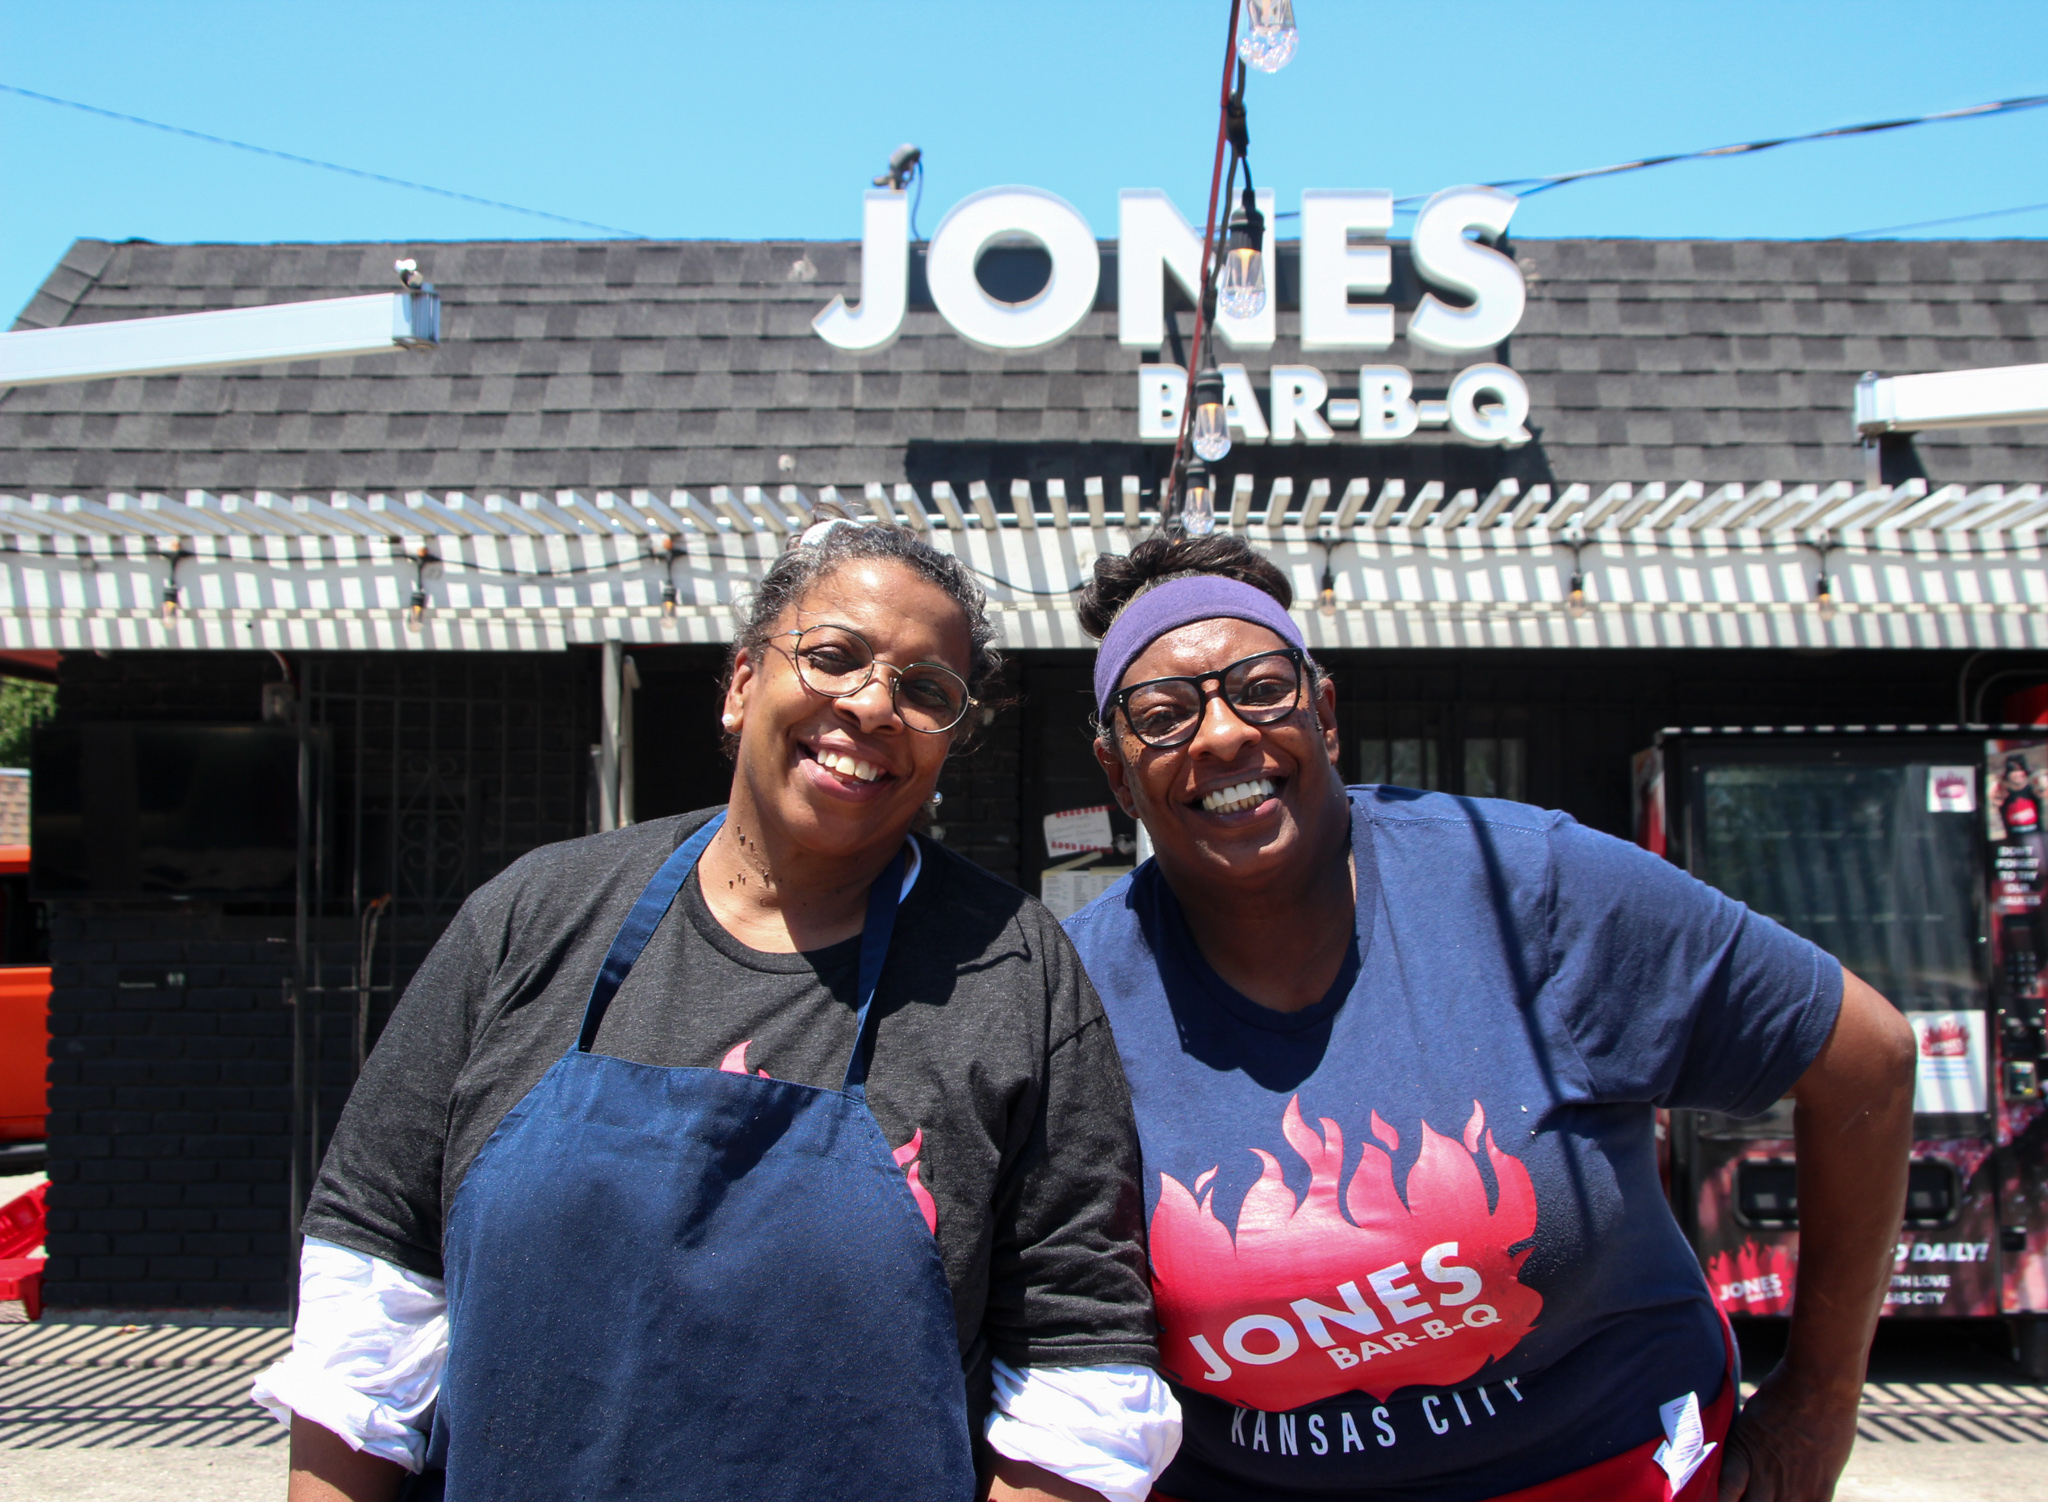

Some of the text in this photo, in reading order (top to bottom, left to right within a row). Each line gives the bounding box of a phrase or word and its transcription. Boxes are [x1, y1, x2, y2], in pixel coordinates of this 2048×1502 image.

[811, 184, 1527, 352] JONES
[1138, 363, 1532, 444] BAR-B-Q
[1911, 1242, 1990, 1262] DAILY!
[1719, 1273, 1783, 1302] JONES
[1911, 1291, 1946, 1305] CITY
[1912, 1274, 1951, 1288] LOVE
[1188, 1241, 1483, 1382] JONES
[1326, 1304, 1502, 1371] BAR-B-Q
[1231, 1406, 1397, 1456] KANSAS
